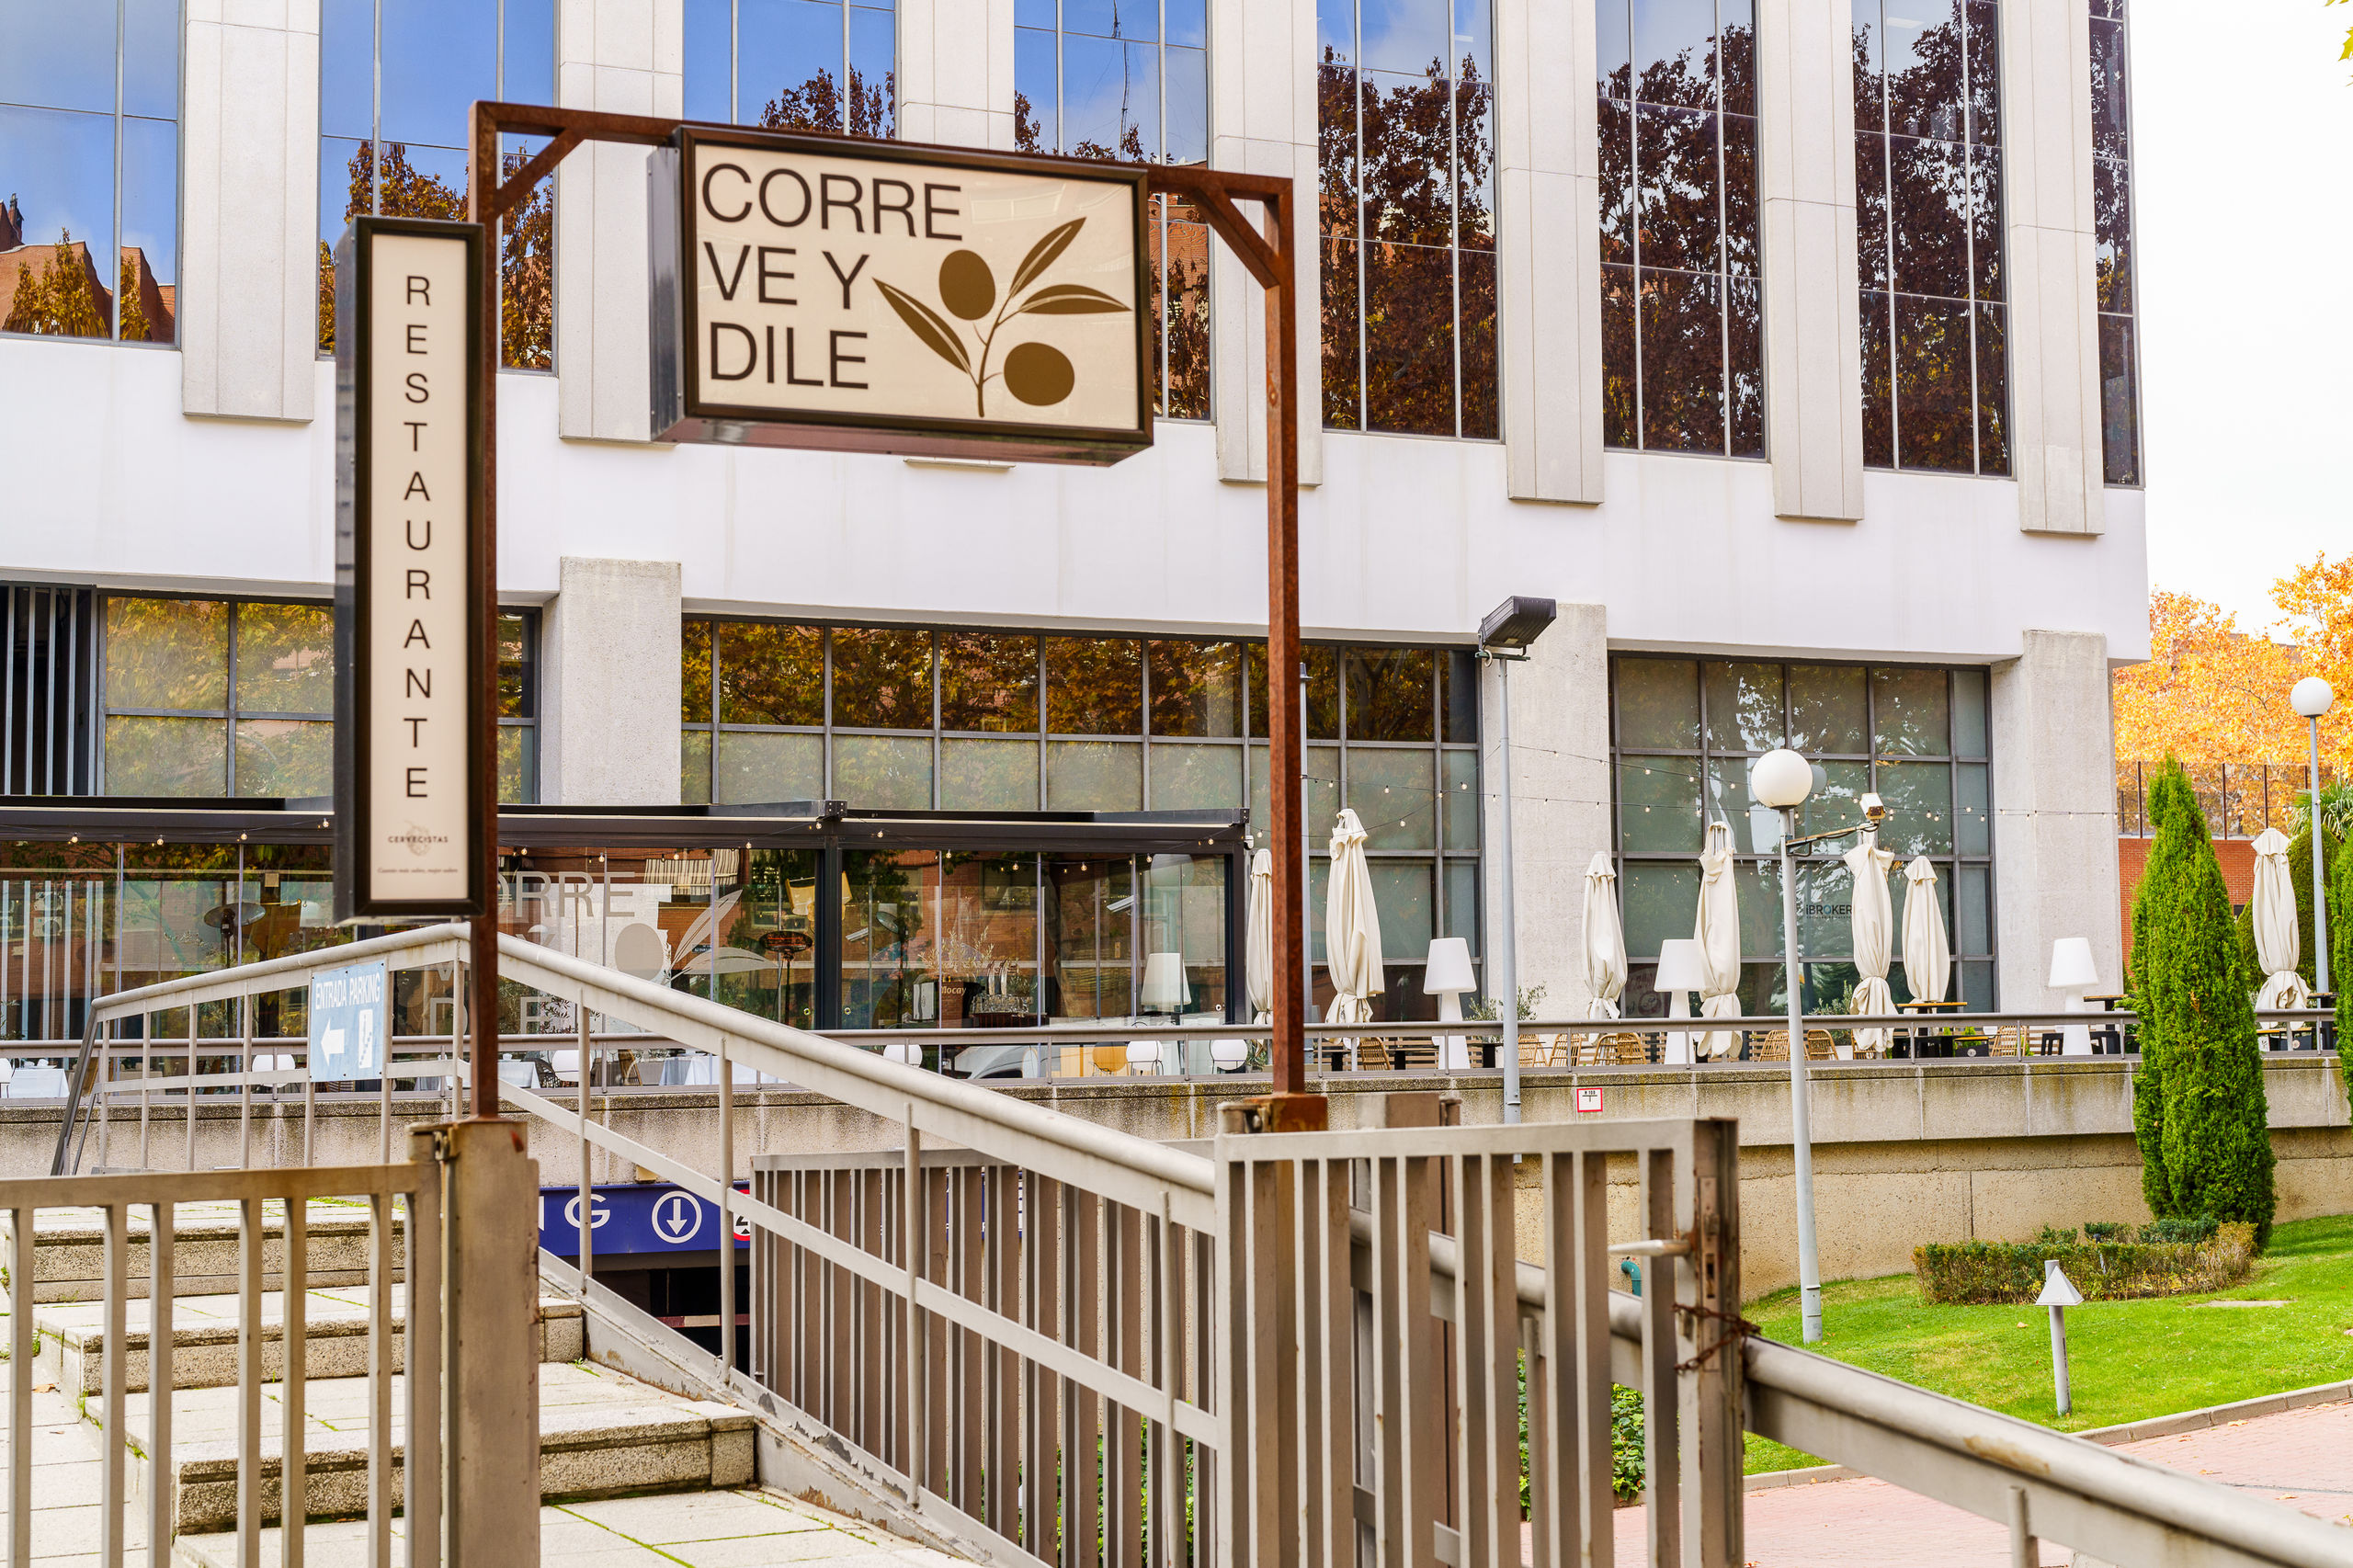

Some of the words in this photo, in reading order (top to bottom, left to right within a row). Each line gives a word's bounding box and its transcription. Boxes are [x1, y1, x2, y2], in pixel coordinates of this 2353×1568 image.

[702, 163, 963, 241] CORRE
[703, 241, 798, 306] VE
[822, 253, 870, 310] Y
[710, 321, 870, 390] DILE
[404, 275, 431, 799] RESTAURANTE
[388, 835, 449, 844] CERVECISTAS
[315, 979, 347, 1010] ENTRADA
[349, 972, 381, 1006] PARKING
